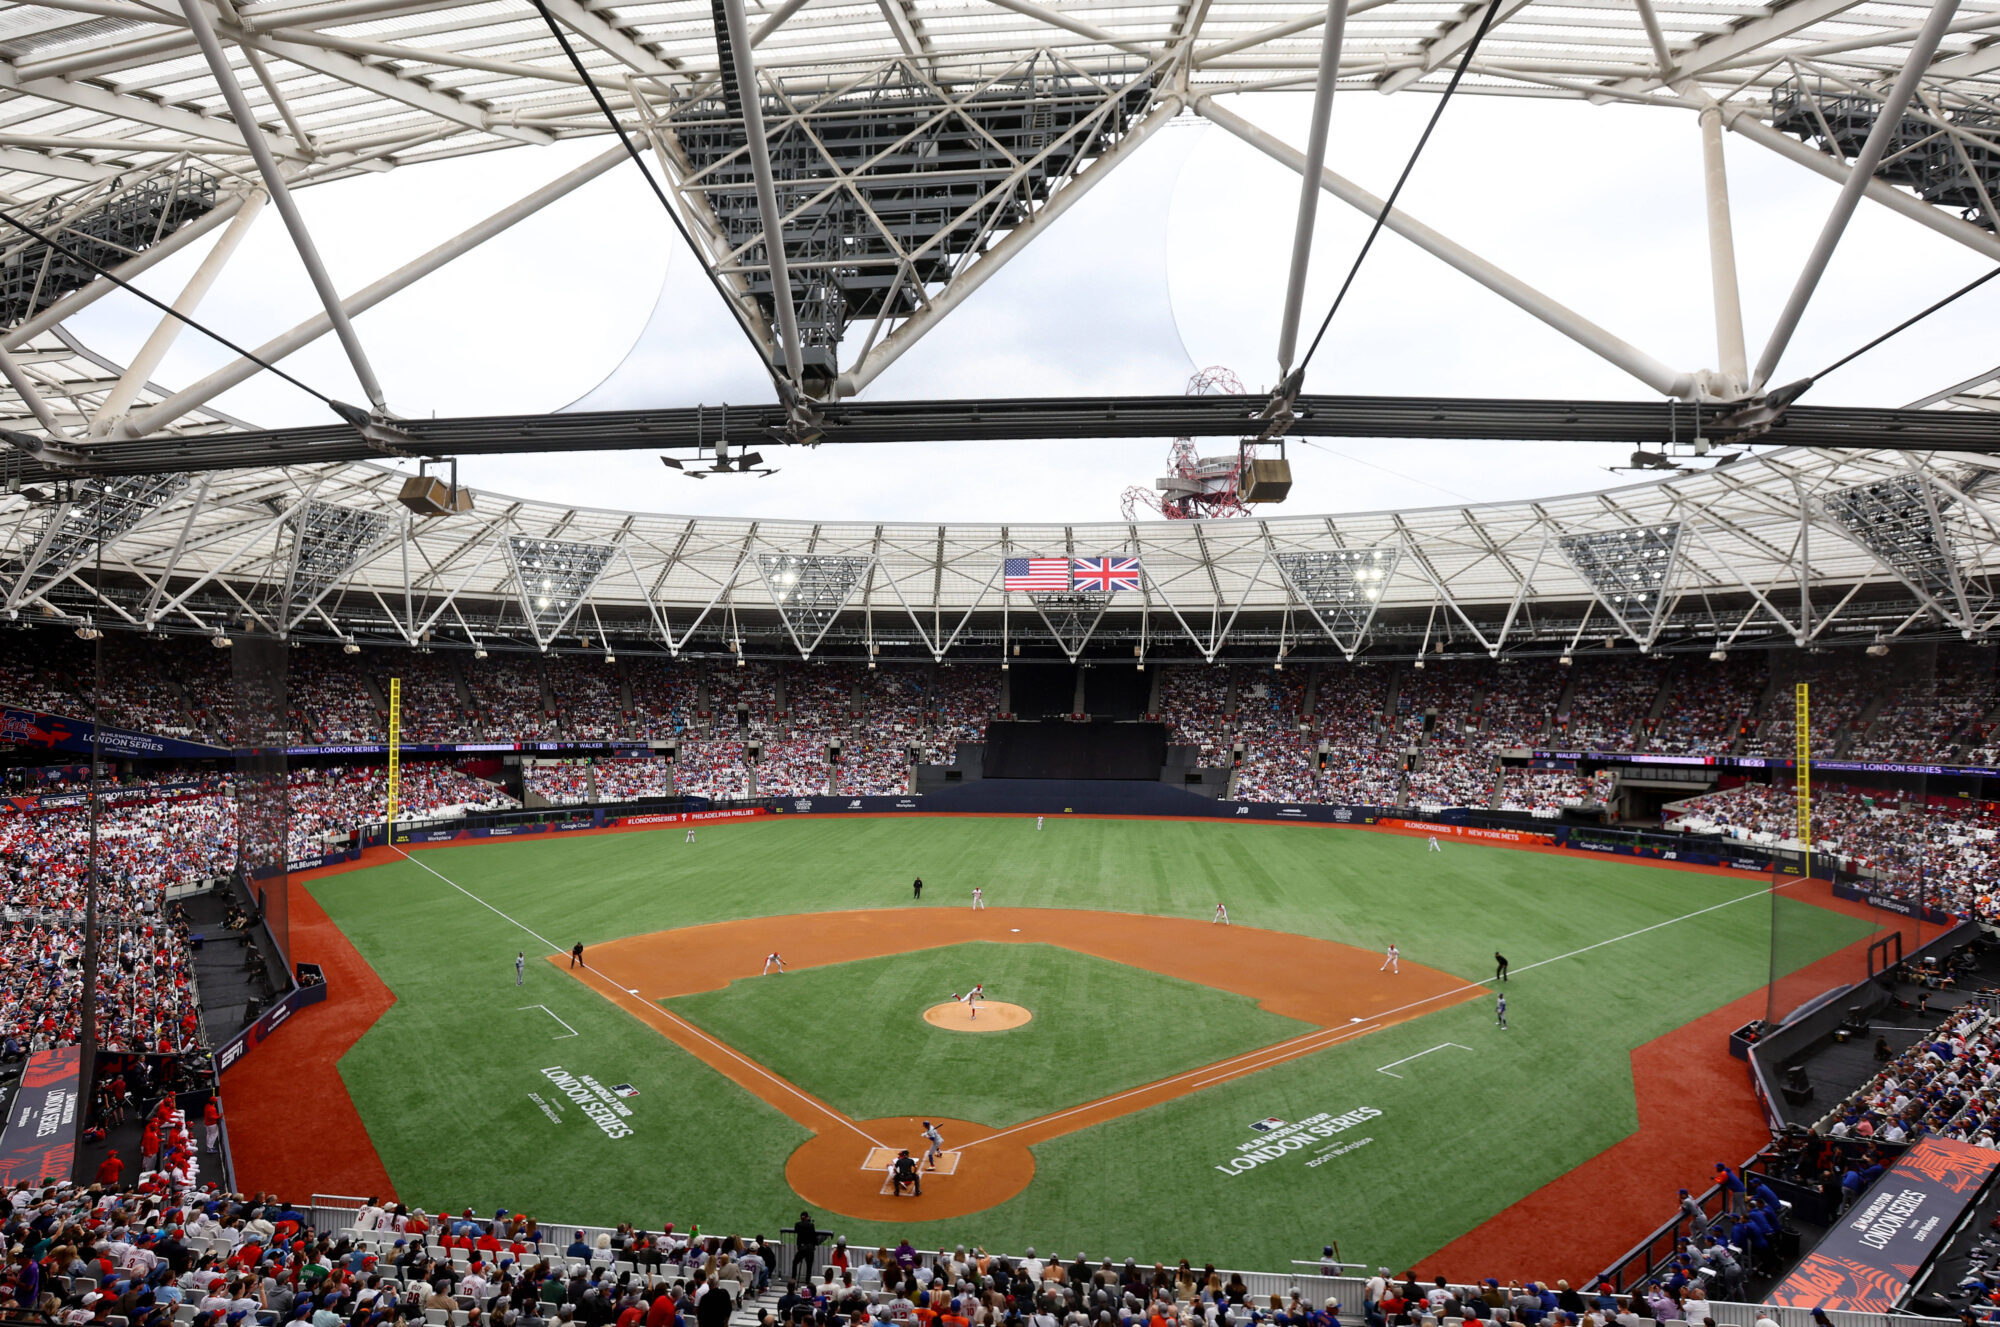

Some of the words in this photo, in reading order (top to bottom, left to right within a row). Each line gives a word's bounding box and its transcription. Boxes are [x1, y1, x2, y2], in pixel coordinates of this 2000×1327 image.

[129, 740, 164, 751] SERIES
[1863, 763, 1905, 772] LONDON
[1906, 765, 1942, 774] SERIES
[691, 812, 731, 820] PHILADELPHIA
[1236, 806, 1249, 815] JTB
[627, 815, 677, 825] #LONDONSERIES
[1404, 822, 1451, 833] #LONDONSERIES
[1468, 829, 1482, 837] NEW
[1484, 830, 1501, 839] YORK
[1501, 833, 1519, 841] METS
[1580, 842, 1598, 850] Google
[221, 1040, 243, 1070] ESPN
[540, 1065, 598, 1105] LONDON
[581, 1102, 634, 1139] SERIES
[591, 1084, 617, 1103] WORLD
[610, 1101, 633, 1117] TOUR
[1237, 1139, 1266, 1152] MLB
[1260, 1123, 1304, 1143] WORLD
[1300, 1112, 1332, 1127] TOUR
[1214, 1132, 1320, 1176] LONDON
[1309, 1106, 1383, 1137] SERIES
[1304, 1152, 1337, 1168] zoom
[1858, 1212, 1907, 1250] LONDON
[1887, 1189, 1927, 1217] SERIES
